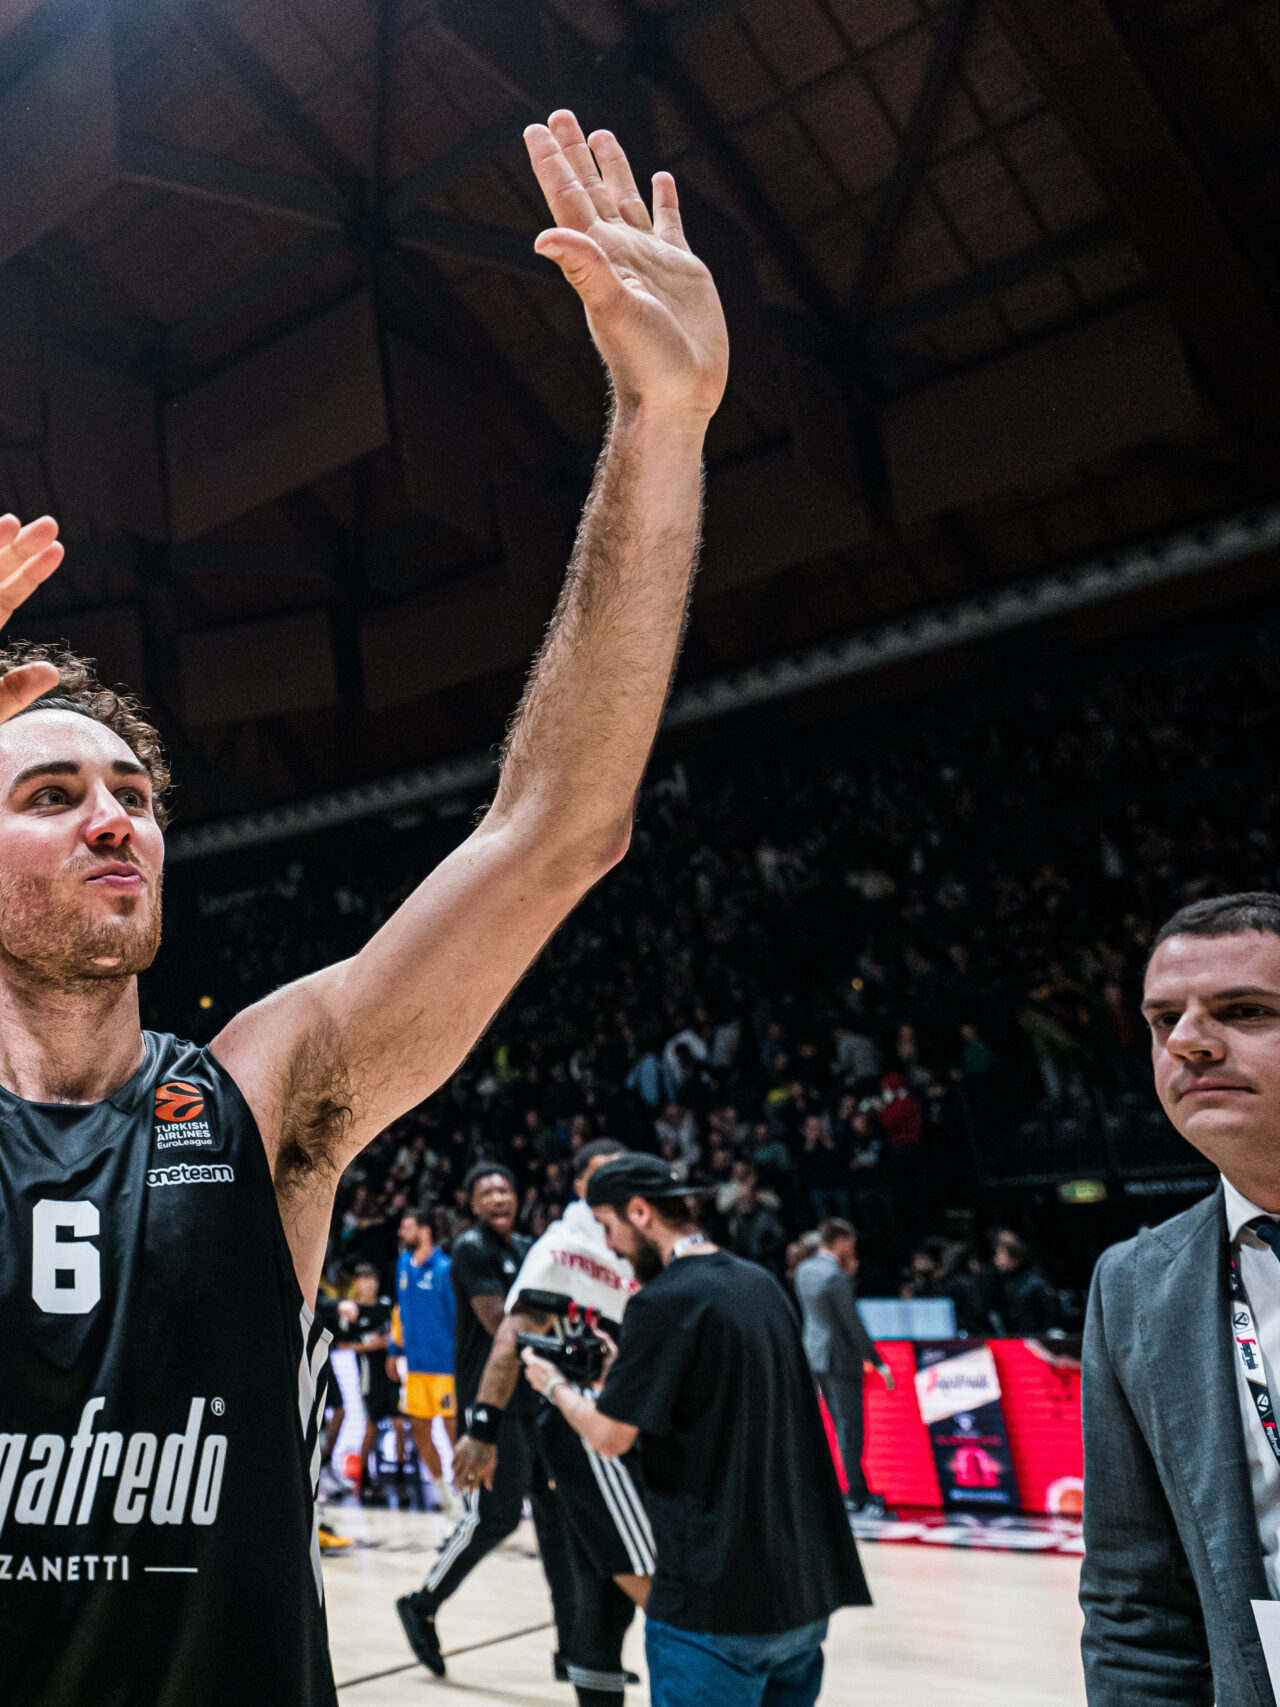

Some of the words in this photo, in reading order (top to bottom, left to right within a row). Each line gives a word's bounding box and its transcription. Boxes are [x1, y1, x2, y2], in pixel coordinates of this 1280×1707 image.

[154, 1121, 209, 1133] TURKISH
[157, 1130, 211, 1142] AIRLINES
[157, 1139, 213, 1150] EuroLeague
[147, 1164, 234, 1186] oneteam
[32, 1199, 100, 1314] 6
